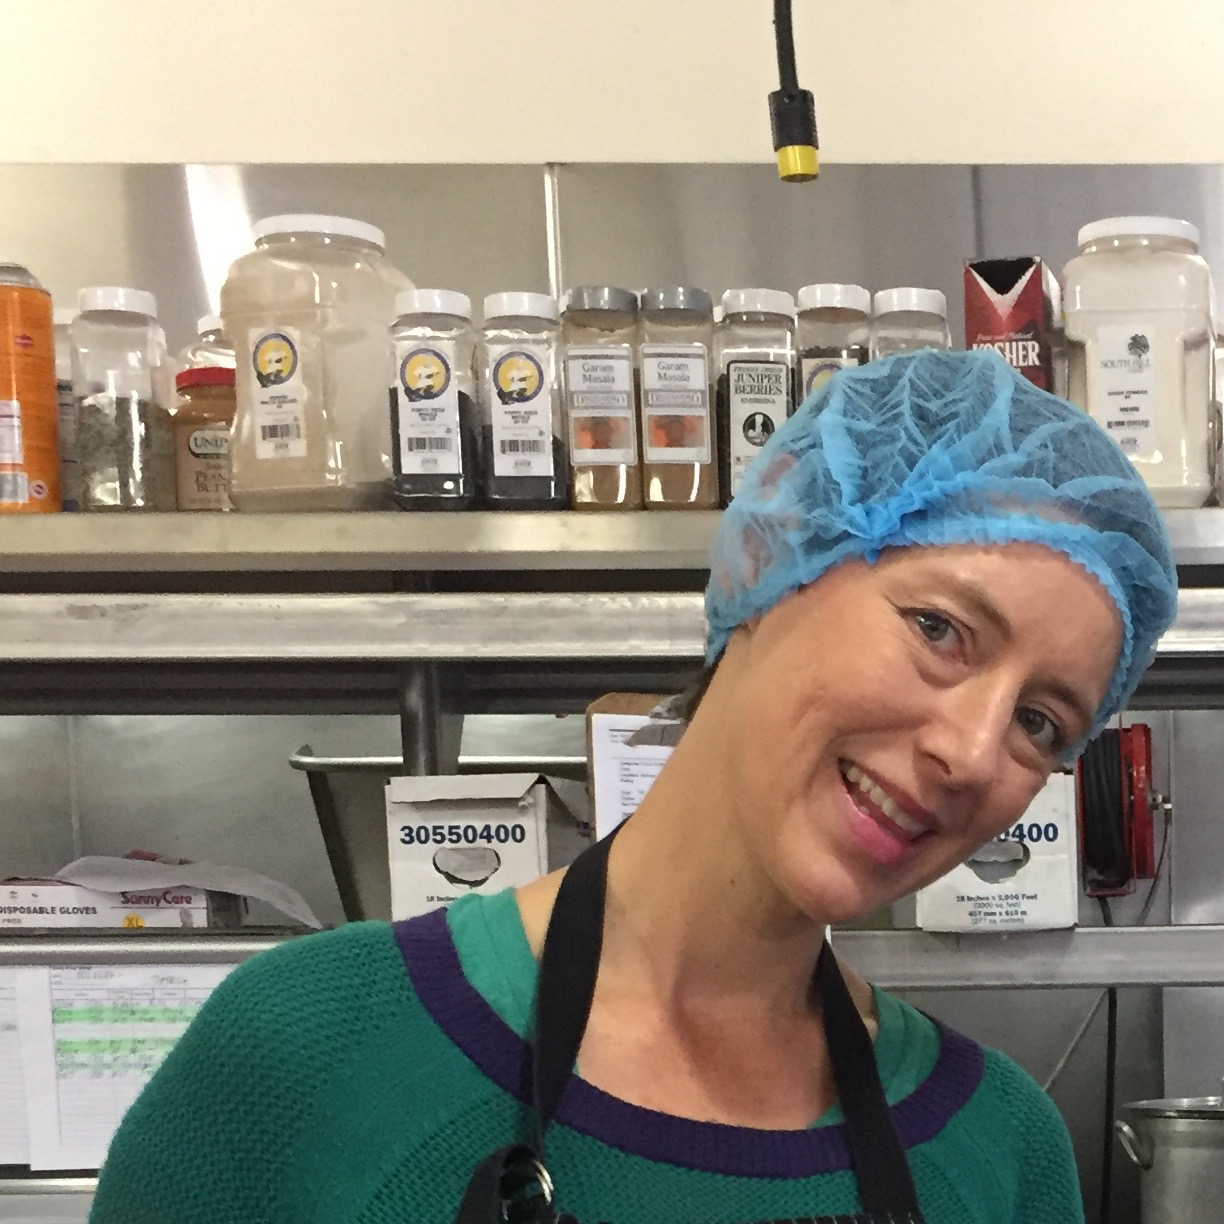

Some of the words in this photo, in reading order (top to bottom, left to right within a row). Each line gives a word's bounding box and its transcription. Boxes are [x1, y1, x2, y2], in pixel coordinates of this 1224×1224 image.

[582, 362, 614, 373] Garam
[657, 361, 689, 372] Garam
[582, 374, 615, 384] Masala
[657, 372, 691, 383] Masala
[734, 373, 782, 384] JUNIPER
[734, 384, 783, 395] BERRIES
[399, 823, 526, 845] 30550400
[0, 905, 57, 915] DISPOSABLE
[59, 906, 98, 915] GLOVES
[126, 917, 143, 928] XL
